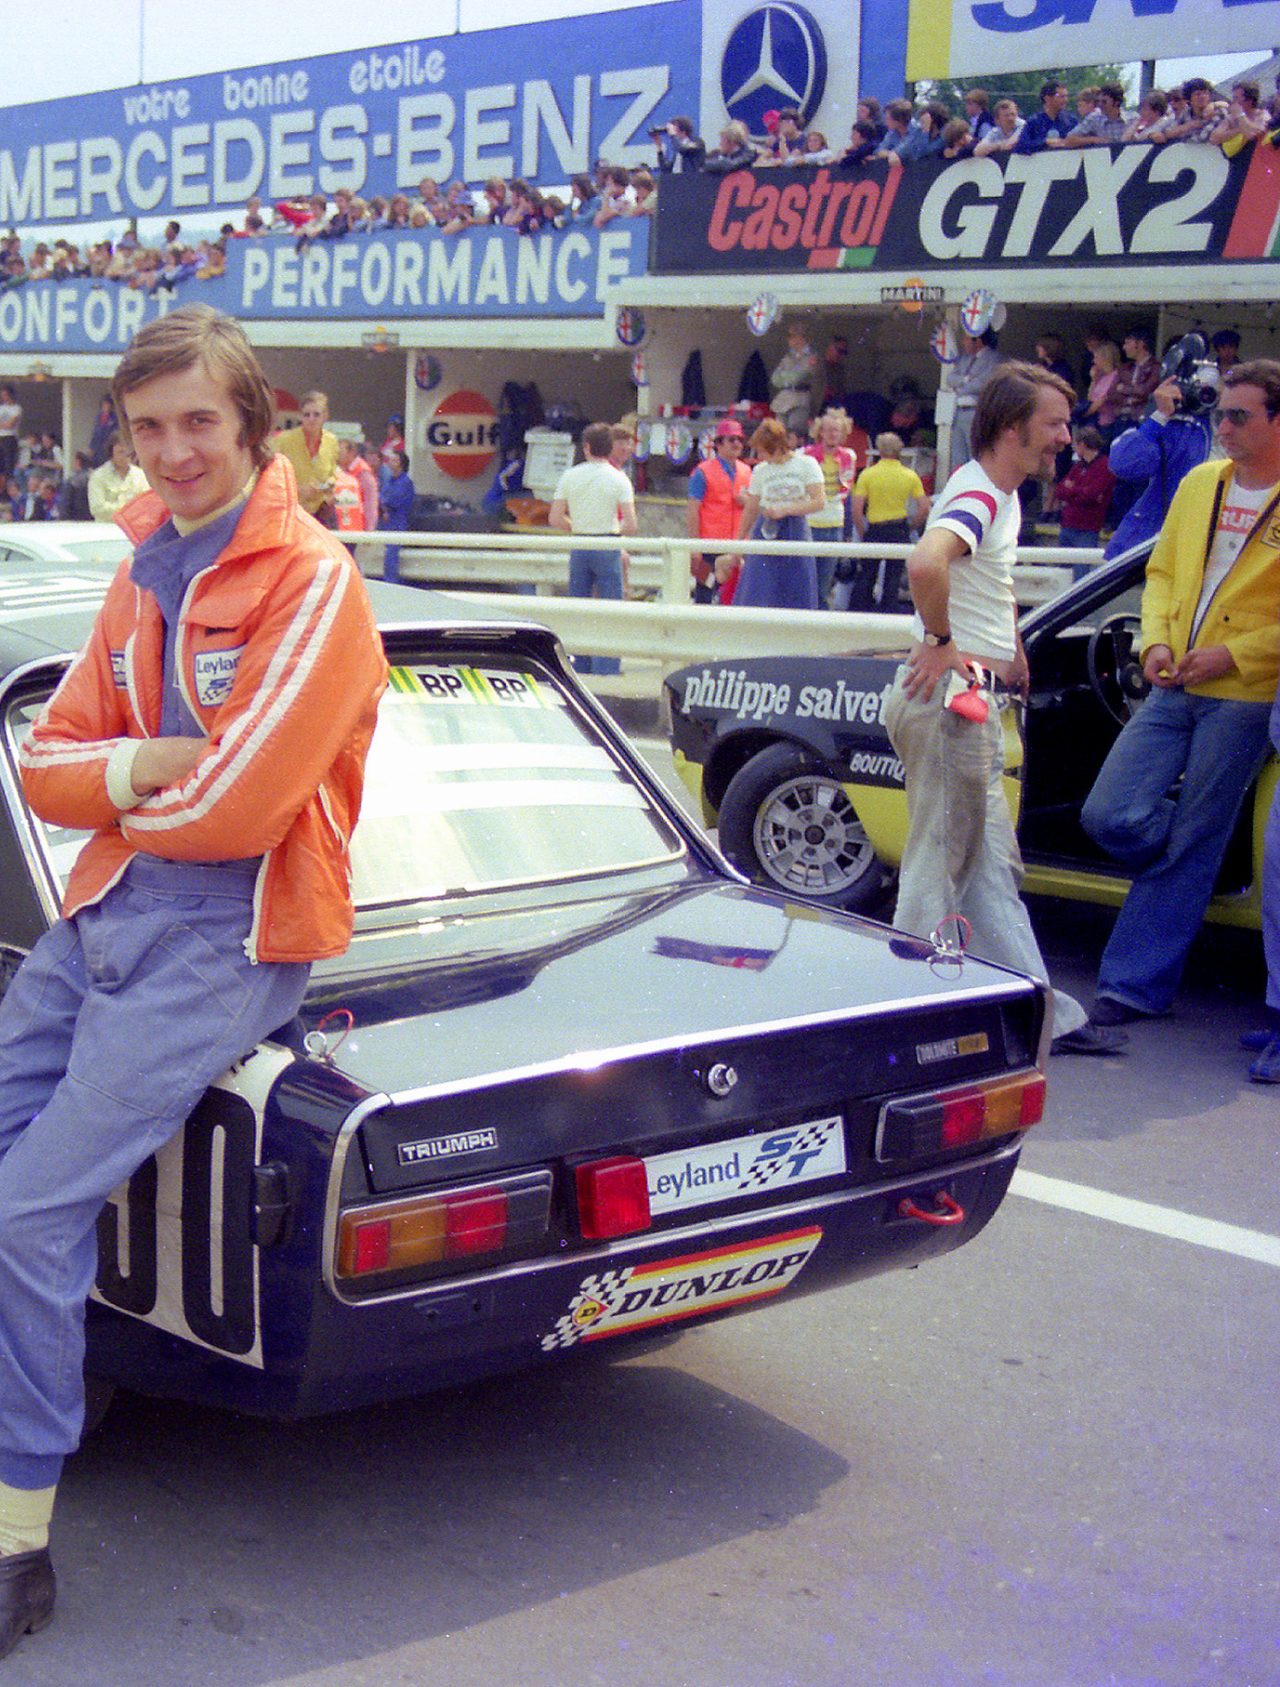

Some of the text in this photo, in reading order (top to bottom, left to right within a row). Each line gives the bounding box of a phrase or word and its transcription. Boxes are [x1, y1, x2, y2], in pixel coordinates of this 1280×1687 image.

[124, 84, 191, 125] votre
[224, 70, 310, 111] bonne
[708, 164, 904, 252] Castrol
[920, 142, 1231, 260] GTX2
[242, 231, 632, 308] PERFORMANCE
[426, 421, 501, 447] Gulf
[682, 669, 791, 720] philippe
[850, 753, 906, 782] BOUTIQ
[402, 1132, 494, 1161] TRIUMPH
[609, 1250, 811, 1317] DUNLOP
